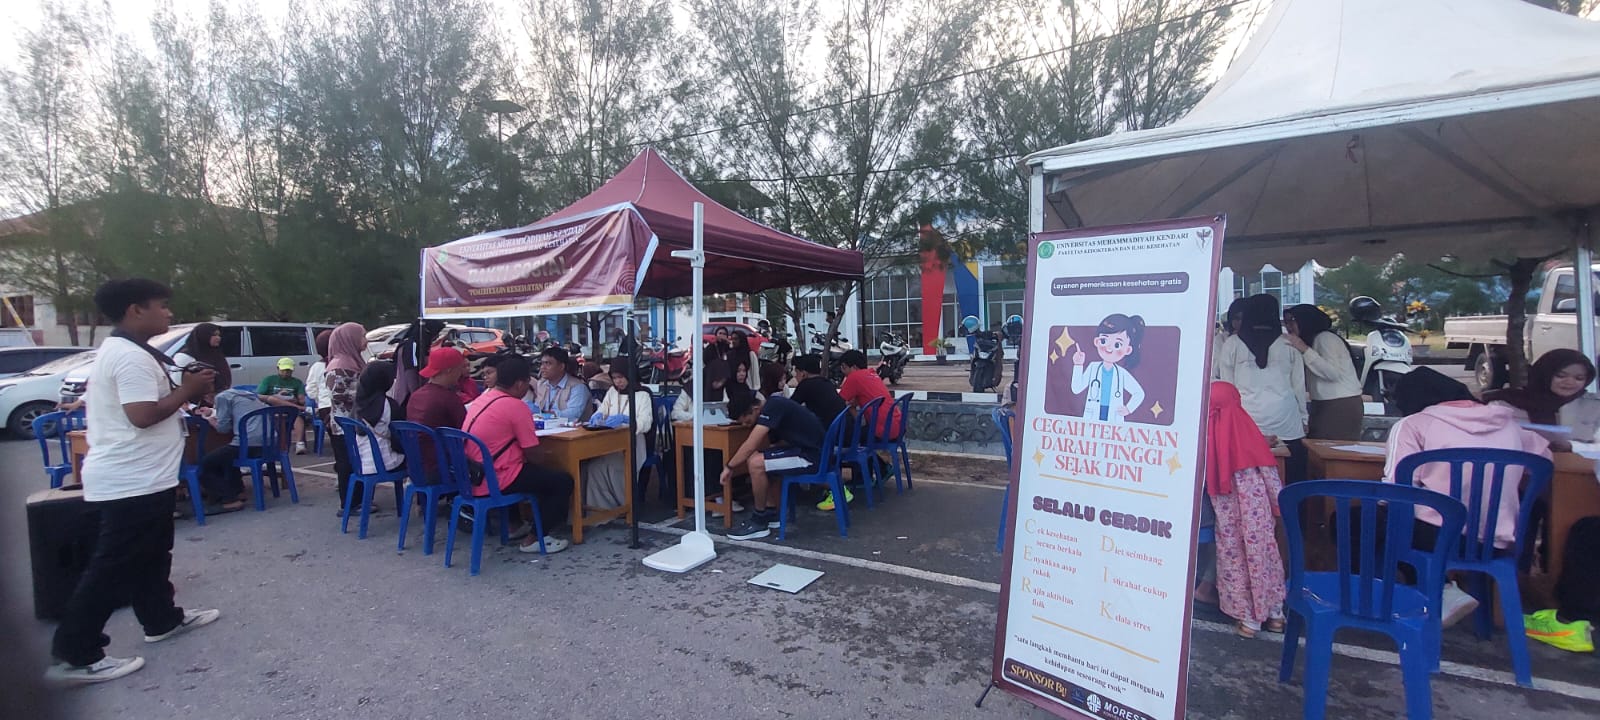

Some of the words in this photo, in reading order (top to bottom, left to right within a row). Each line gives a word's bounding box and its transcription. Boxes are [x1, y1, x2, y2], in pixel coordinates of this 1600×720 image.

[1057, 240, 1096, 249] UNIVERSITAS
[1097, 236, 1155, 246] MUHAMMADIYAH
[1156, 232, 1189, 241] KENDARI
[1053, 282, 1079, 291] Layanan
[1123, 279, 1159, 288] kesehatan
[1160, 278, 1182, 287] gratis
[1032, 416, 1086, 437] CEGAH
[1089, 423, 1179, 448] TEKANAN
[1041, 435, 1098, 457] DARAH
[1101, 443, 1164, 466] TINGGI
[1054, 455, 1101, 476] SEJAK
[1105, 463, 1143, 483] DINI
[1032, 495, 1096, 522] SELALU
[1099, 509, 1173, 539] CERDIK
[1143, 586, 1168, 600] cukup
[1010, 664, 1055, 689] SPONSOR
[1086, 660, 1100, 673] hari
[1101, 665, 1109, 677] ini
[1110, 671, 1129, 685] dapat
